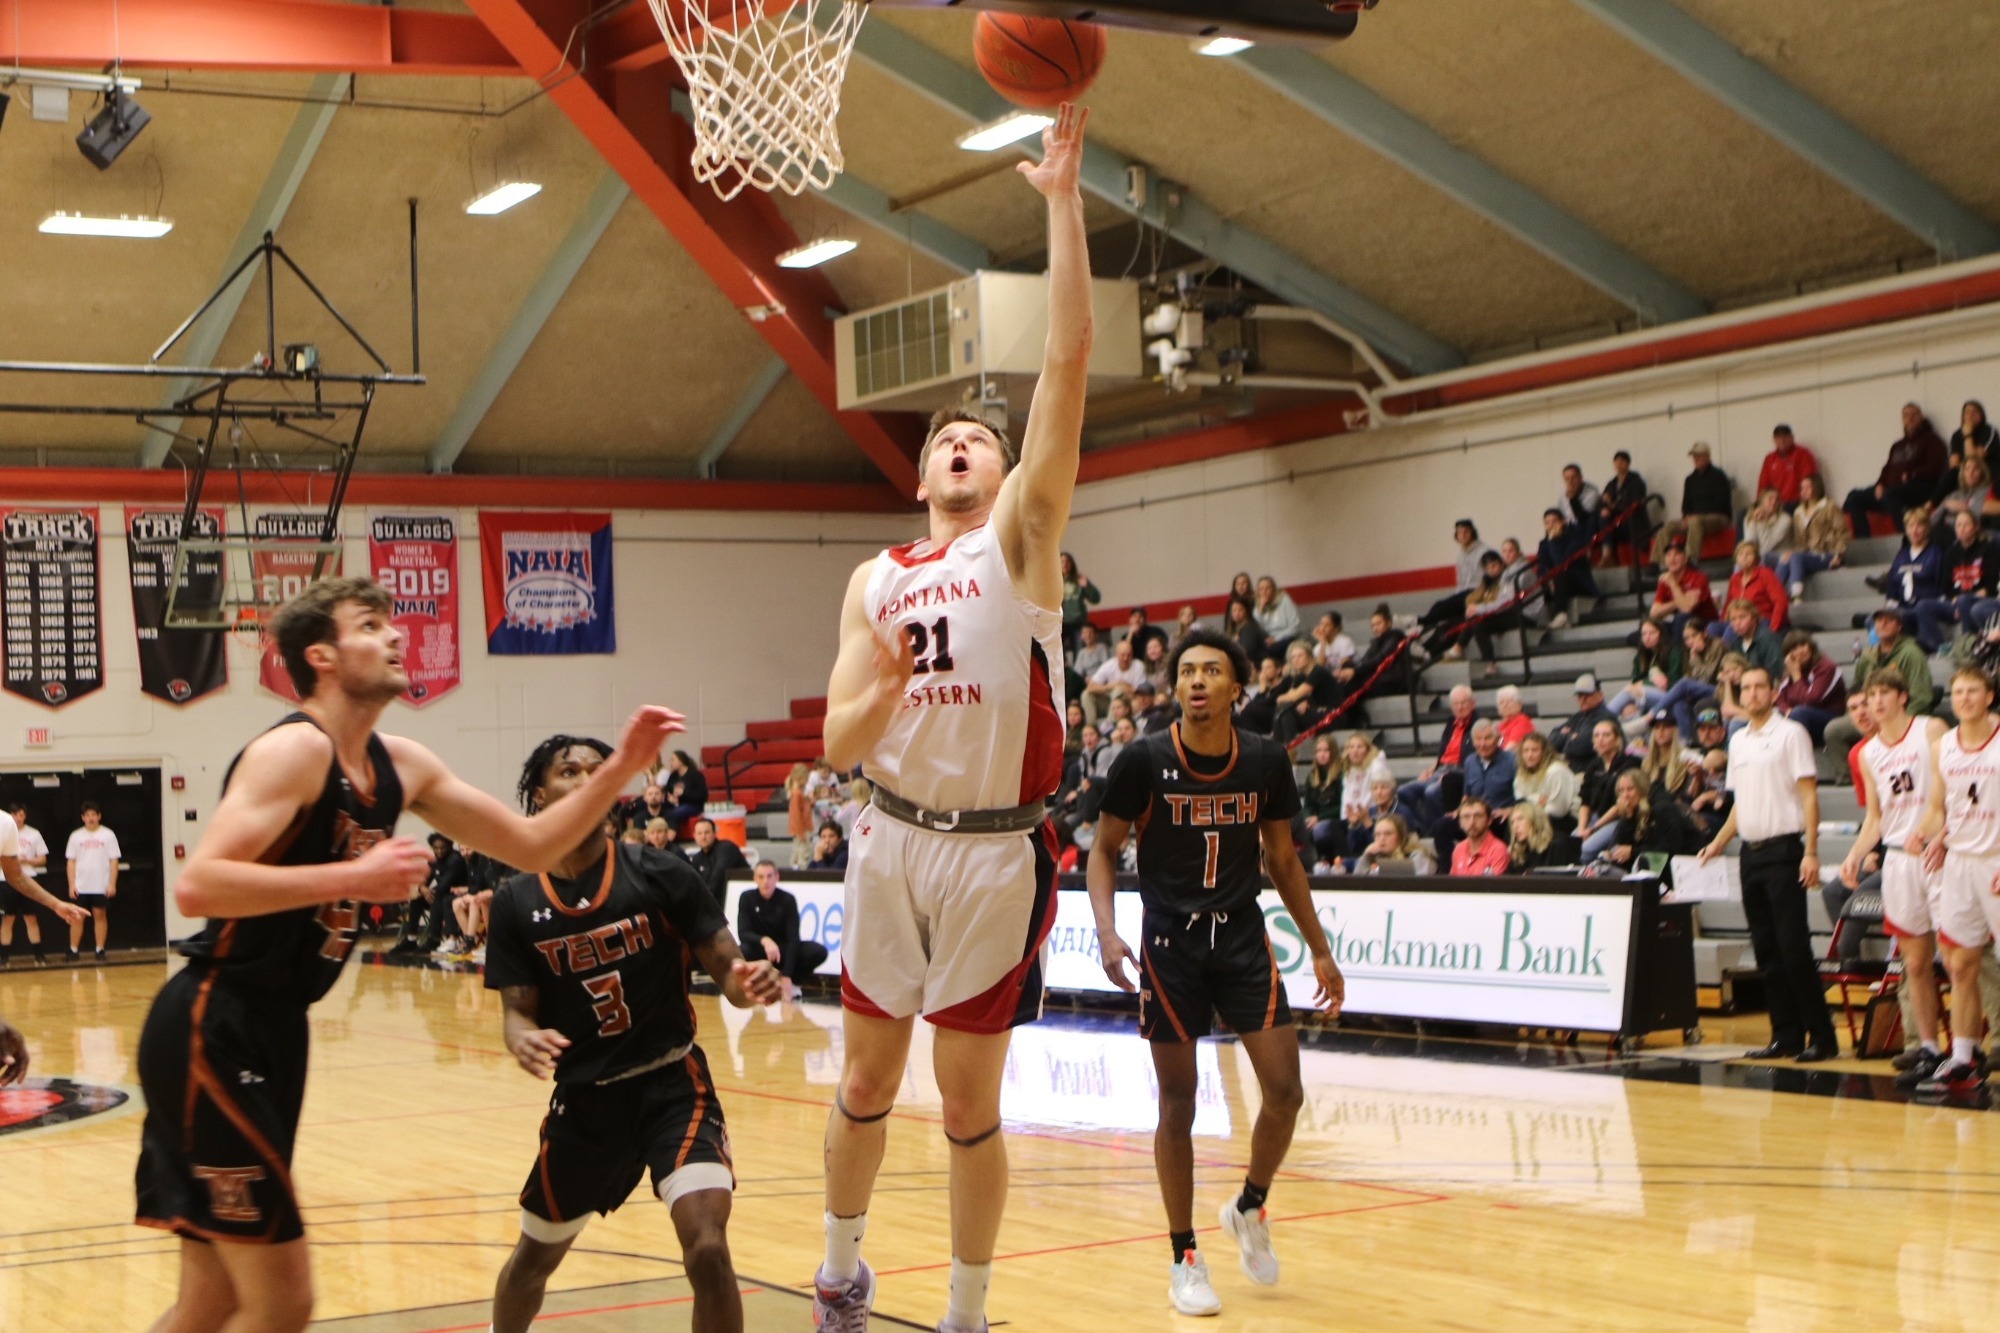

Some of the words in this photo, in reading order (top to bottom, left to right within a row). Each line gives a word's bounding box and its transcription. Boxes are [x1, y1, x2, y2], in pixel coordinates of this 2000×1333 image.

[8, 518, 89, 541] TRACK
[136, 518, 212, 540] TRAK
[258, 520, 336, 538] BULLDOG
[375, 522, 452, 540] BULLDOGS
[36, 539, 63, 552] MEN'S
[393, 545, 433, 557] WOMEN'S
[5, 562, 30, 574] 1940
[39, 562, 62, 574] 1941
[272, 551, 317, 566] BASKETBA
[389, 556, 438, 568] BASKETBALL
[507, 550, 588, 583] NAIA
[378, 568, 450, 597] 2019
[518, 588, 577, 598] Champions
[394, 600, 437, 619] NAIA
[515, 599, 527, 609] of
[529, 600, 582, 609] Character
[877, 578, 982, 625] MONTANA
[903, 615, 954, 676] 21
[9, 668, 33, 681] 1977
[902, 683, 982, 710] ESTERN
[28, 728, 49, 744] EXIT
[1889, 771, 1915, 796] 20
[1967, 782, 1979, 805] 4
[1164, 792, 1259, 826] TECH
[1203, 831, 1220, 889] 1
[534, 912, 654, 976] TECH
[1495, 910, 1607, 977] Bank
[581, 969, 632, 1037] 3
